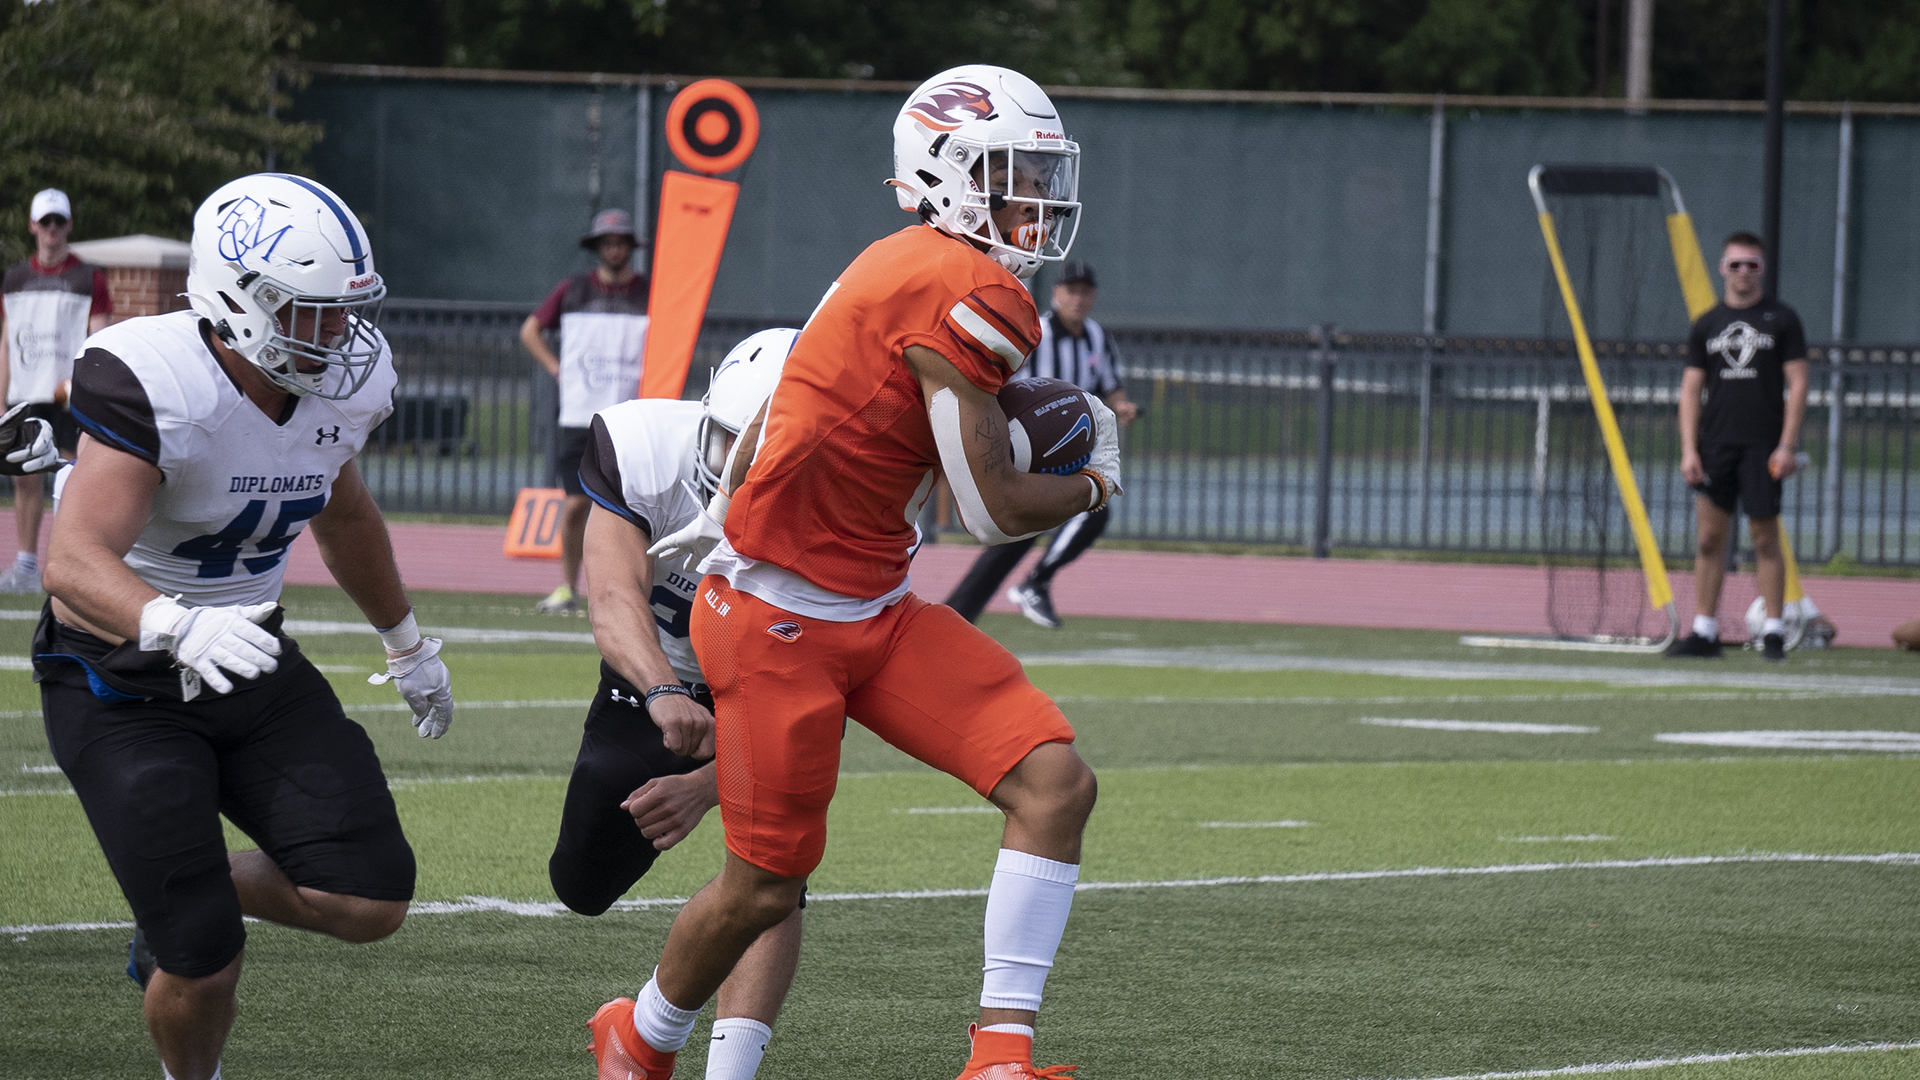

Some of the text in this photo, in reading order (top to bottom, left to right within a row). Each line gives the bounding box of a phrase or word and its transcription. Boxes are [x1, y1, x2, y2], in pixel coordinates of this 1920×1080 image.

[350, 275, 375, 290] Riddell
[229, 474, 324, 493] DIPLOMATS
[170, 492, 326, 578] 45
[519, 498, 564, 546] 10
[666, 572, 699, 596] DIP
[704, 588, 731, 617] ALL IN
